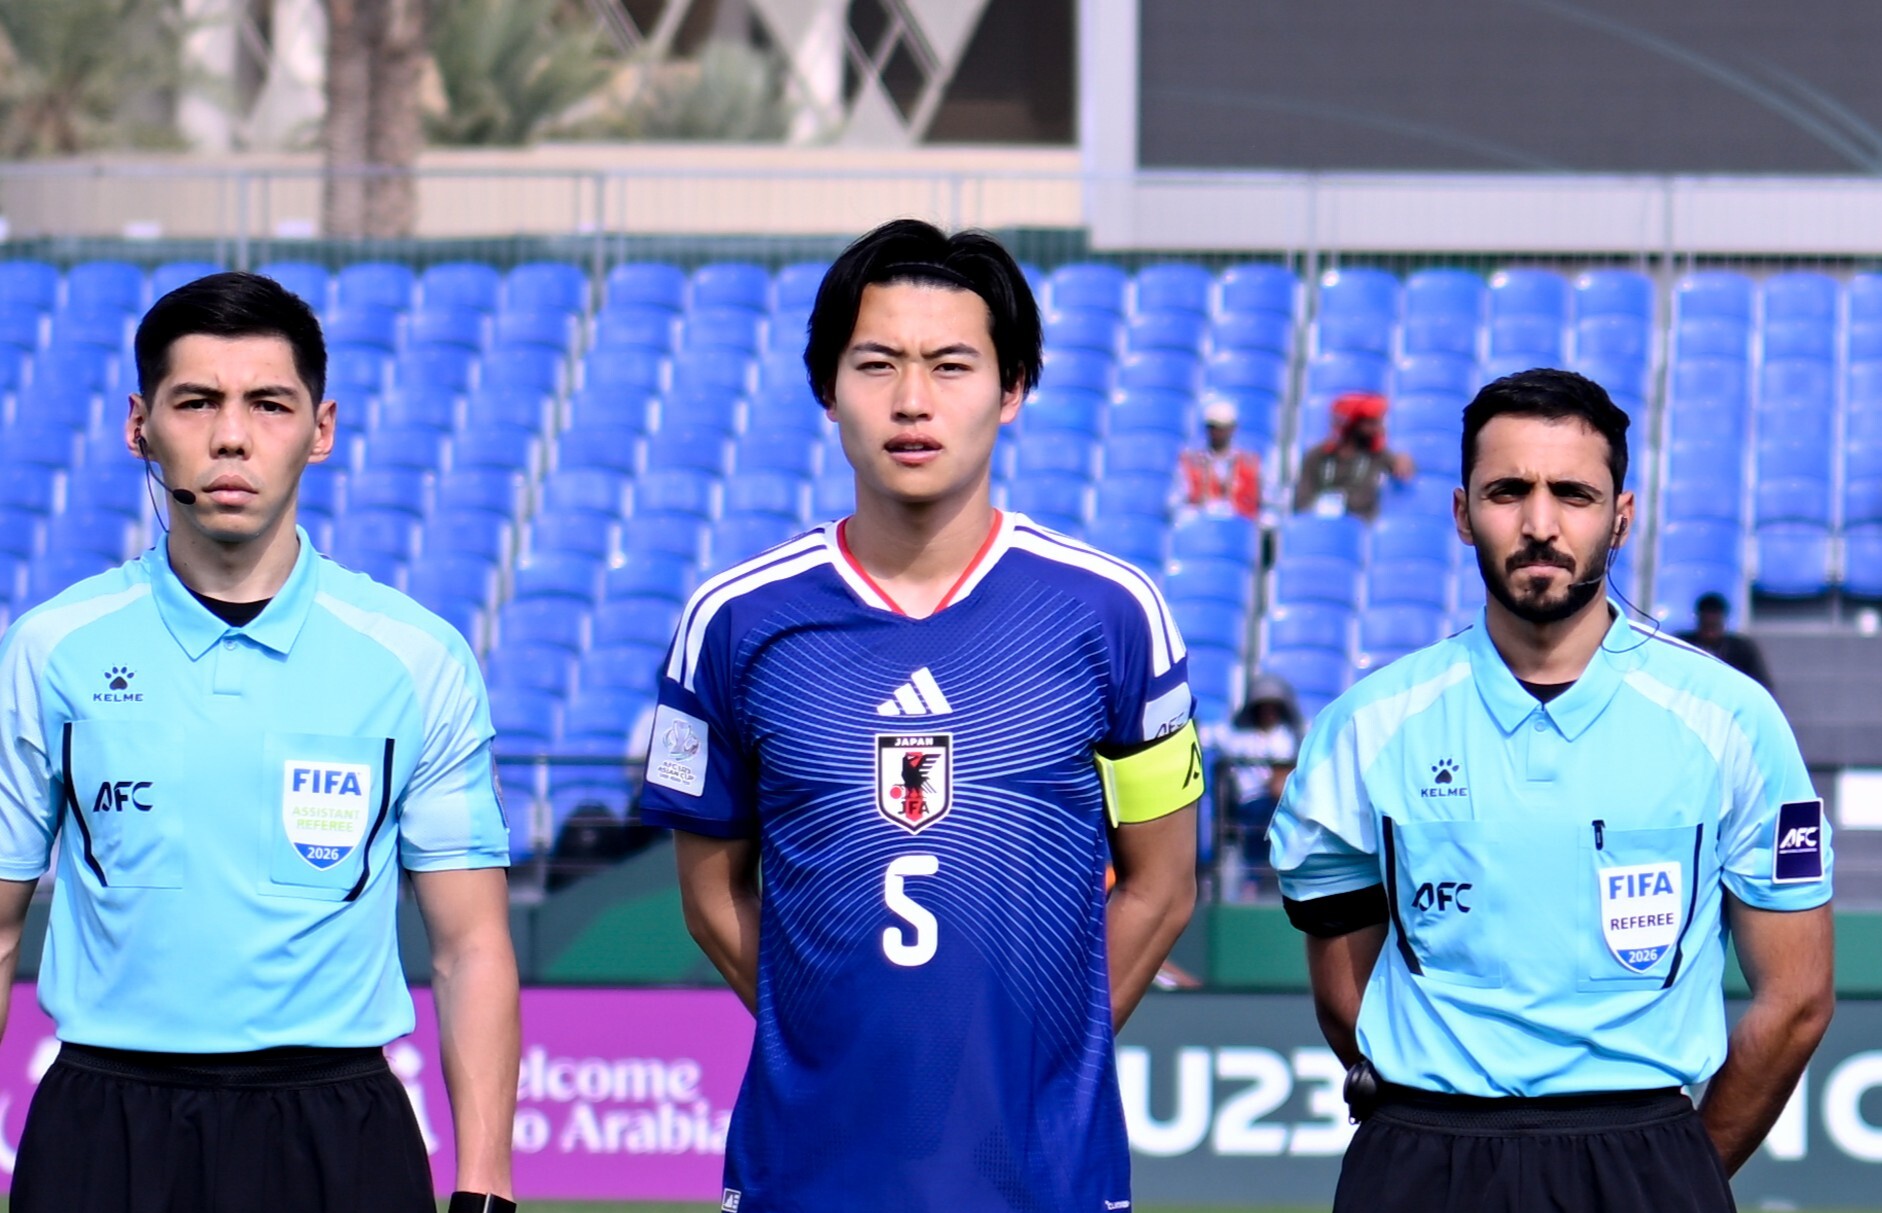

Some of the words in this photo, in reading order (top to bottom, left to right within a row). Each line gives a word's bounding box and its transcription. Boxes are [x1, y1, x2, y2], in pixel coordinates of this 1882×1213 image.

[93, 693, 144, 702] KELME
[894, 737, 934, 747] JAPAN
[293, 768, 362, 796] FIFA
[93, 781, 153, 812] AFC
[1421, 787, 1468, 798] KELME
[292, 805, 361, 819] ASSISTANT
[898, 801, 930, 815] JFA
[296, 818, 354, 832] REFEREE
[1779, 826, 1819, 849] AFC
[307, 847, 340, 860] 2026
[1609, 871, 1674, 900] FIFA
[1411, 882, 1473, 913] AFC
[882, 855, 940, 967] 5
[1610, 912, 1675, 931] REFEREE
[1629, 949, 1658, 963] 2026
[1116, 1046, 1355, 1157] U23
